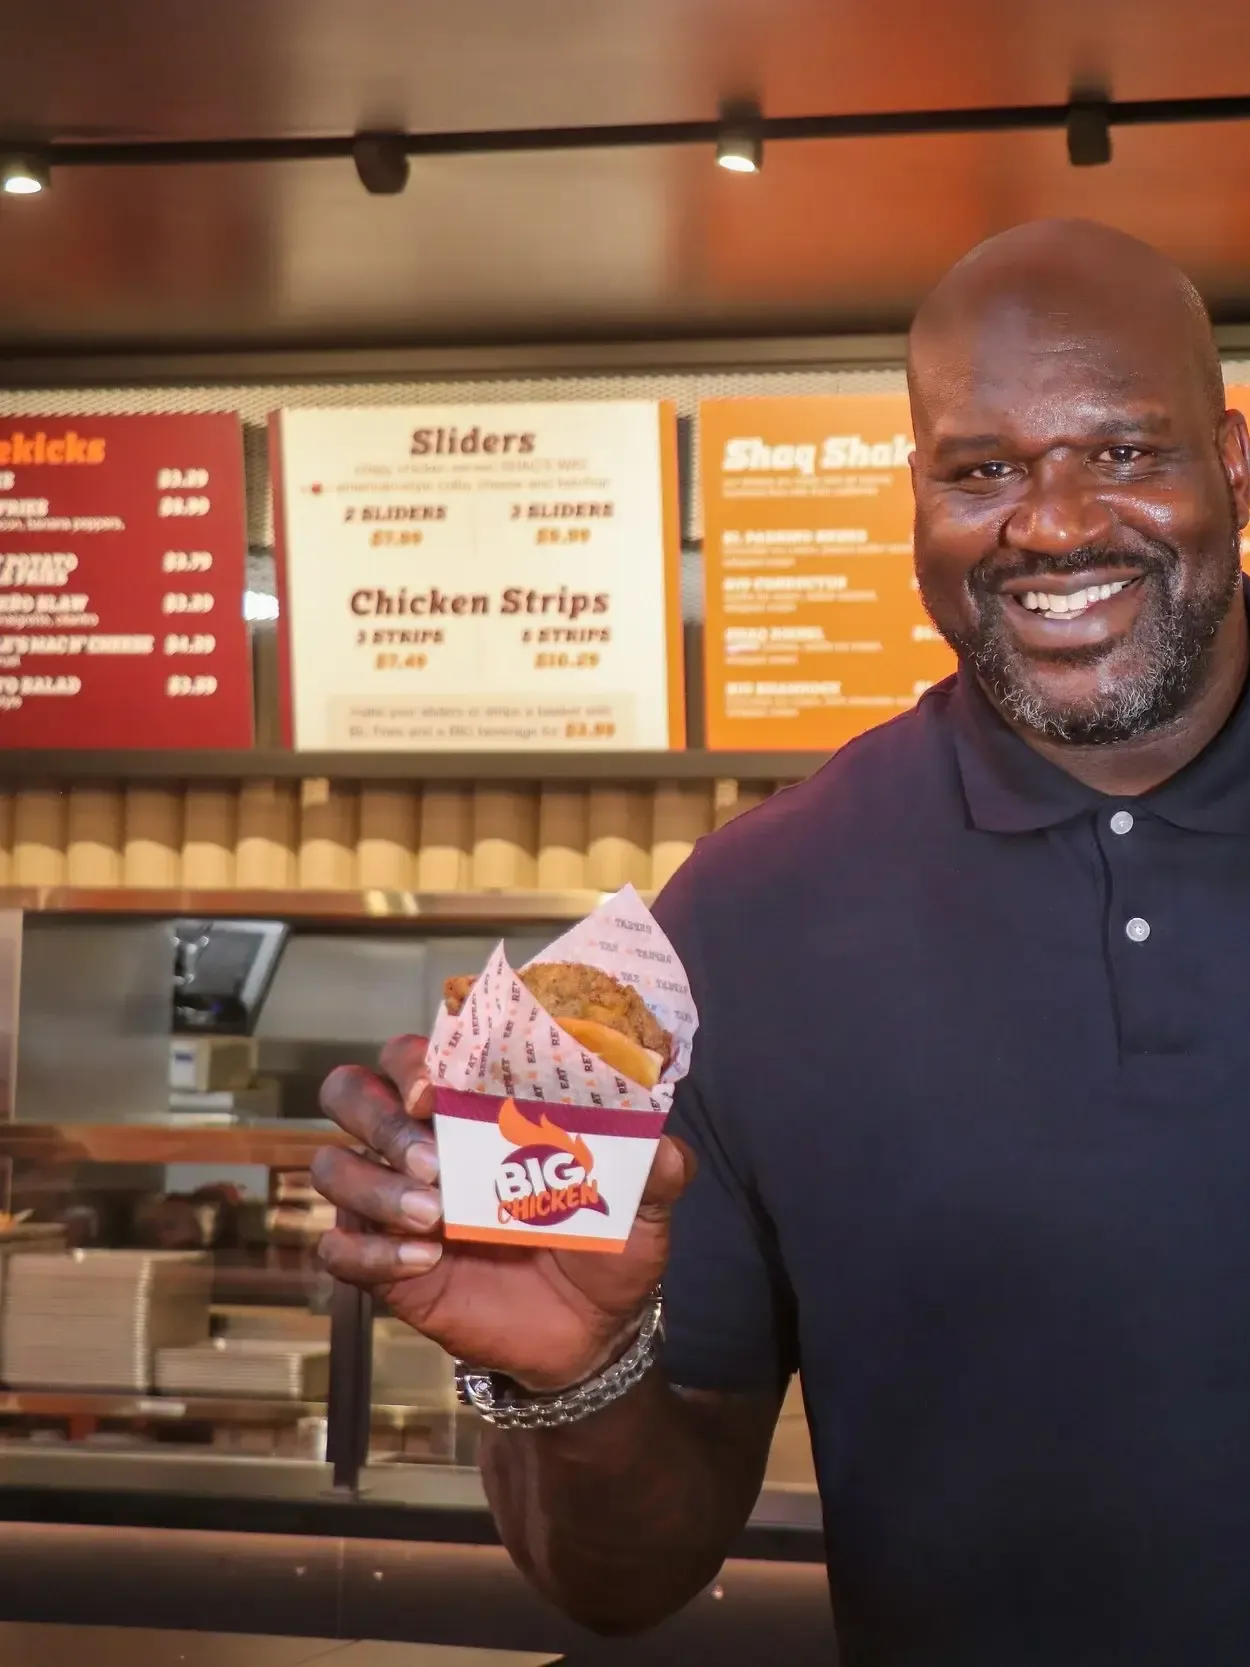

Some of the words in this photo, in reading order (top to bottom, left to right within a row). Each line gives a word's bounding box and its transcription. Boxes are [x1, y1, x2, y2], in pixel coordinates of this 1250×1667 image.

[409, 426, 537, 456] Sliders
[722, 436, 817, 477] Shaq
[361, 505, 448, 521] SLIDERS
[528, 502, 615, 518] SLIDERS
[348, 587, 491, 617] Chicken
[499, 584, 611, 621] Strips
[372, 629, 445, 645] STRIPS
[538, 626, 613, 642] STRIPS
[527, 1040, 537, 1065] EAT
[557, 1066, 570, 1091] EAT
[532, 1083, 545, 1101] AT
[592, 1091, 604, 1107] AT
[497, 1150, 586, 1202] BIG
[498, 1179, 600, 1226] CHICKEN
